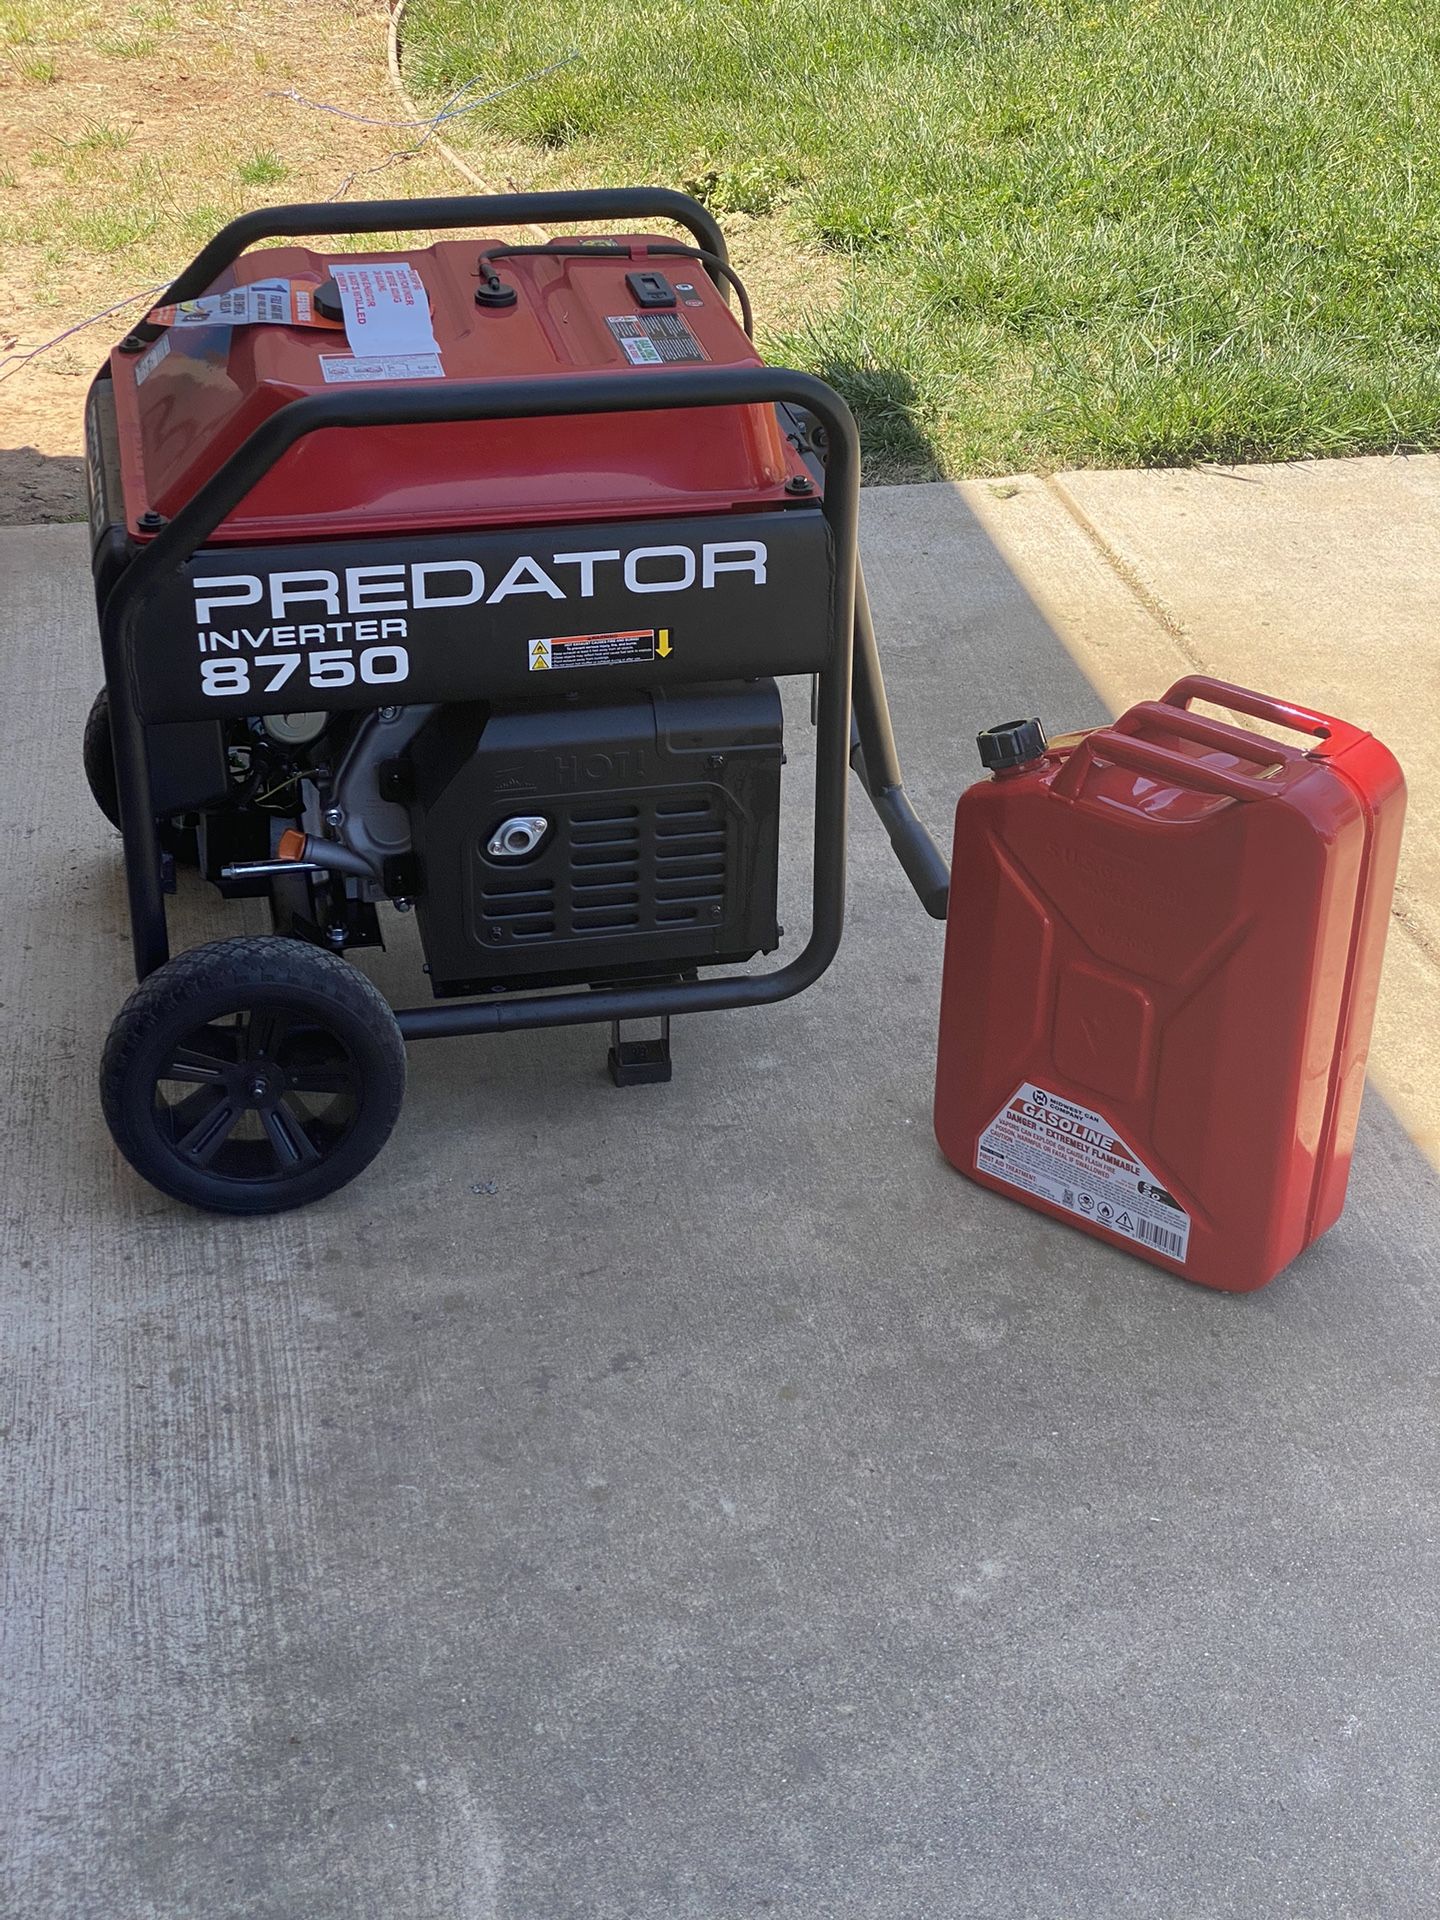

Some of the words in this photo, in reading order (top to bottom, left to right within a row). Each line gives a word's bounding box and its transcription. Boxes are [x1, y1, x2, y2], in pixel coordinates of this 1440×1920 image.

[193, 541, 768, 624] PREDATOR
[197, 618, 408, 653] INVERTER
[200, 646, 409, 697] 8750
[1022, 1102, 1114, 1151] GASOLINE
[1049, 1103, 1084, 1121] COMPANY
[1050, 1097, 1082, 1115] MIDWEST
[1085, 1112, 1099, 1123] CAN
[1006, 1111, 1037, 1131] DANGER
[1046, 1128, 1091, 1153] EXTREMELY
[1091, 1148, 1140, 1176] FLAMMABLE
[1005, 1163, 1037, 1182] TREATMENT
